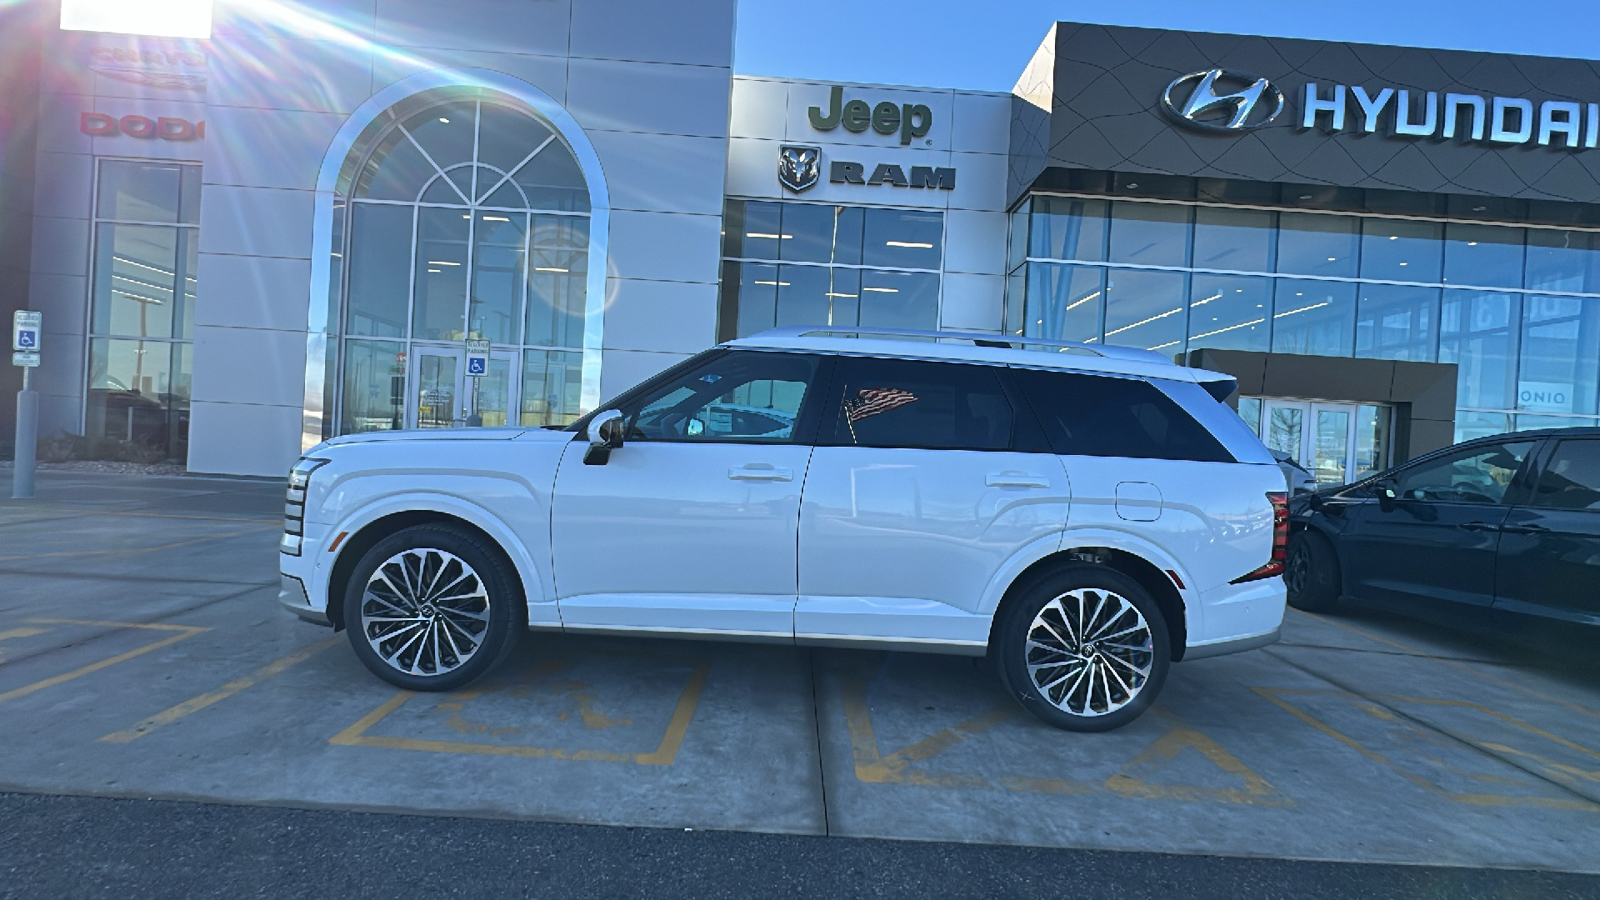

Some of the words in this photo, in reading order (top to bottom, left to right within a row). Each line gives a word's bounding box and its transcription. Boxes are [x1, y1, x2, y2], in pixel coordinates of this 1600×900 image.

[80, 112, 206, 140] DOD
[808, 86, 932, 145] Jeep
[1303, 83, 1598, 148] HYUNDAI
[830, 161, 956, 190] RAM
